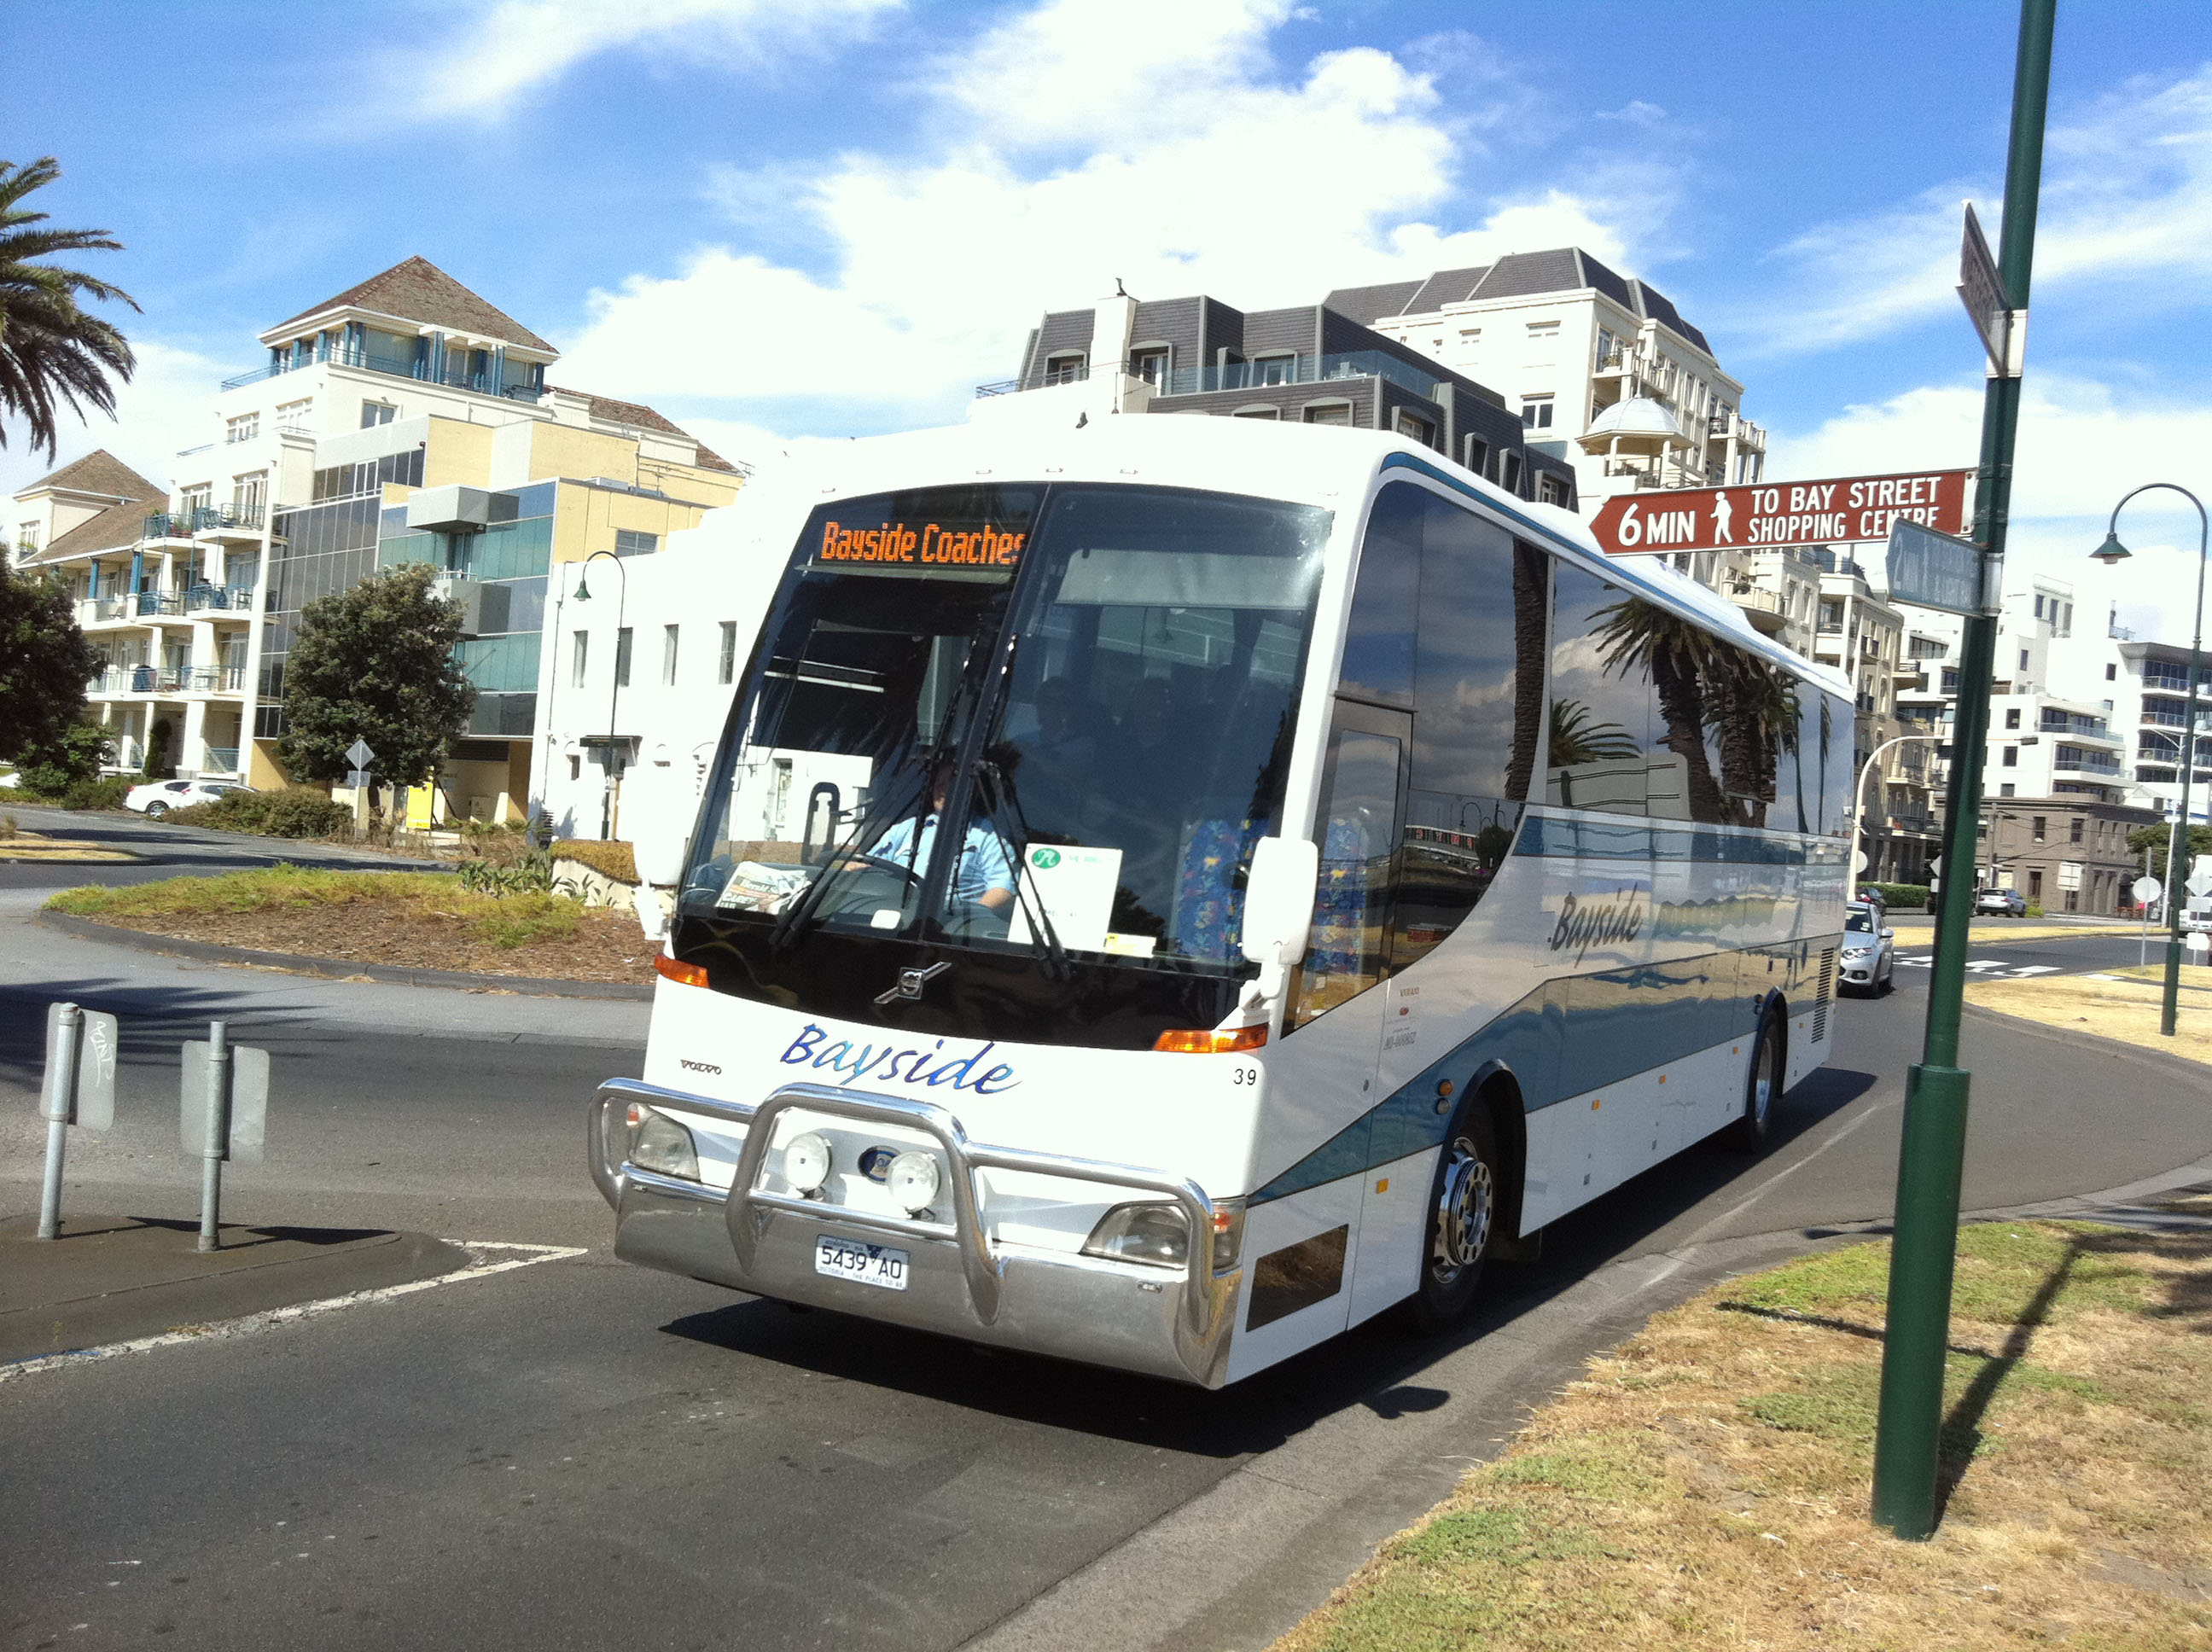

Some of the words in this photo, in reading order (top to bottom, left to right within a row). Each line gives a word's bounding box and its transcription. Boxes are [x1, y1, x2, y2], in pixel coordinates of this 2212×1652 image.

[1751, 487, 1779, 514] TO
[1790, 483, 1837, 512] BAY
[1848, 475, 1941, 508] STREET
[821, 521, 917, 562] Bayside
[1618, 503, 1642, 547] 6
[1646, 509, 1696, 544] MIN
[1747, 511, 1847, 543] SHOPPING
[1551, 881, 1644, 969] Bayside
[680, 1059, 722, 1075] VOLVO
[780, 1023, 1022, 1094] Bayside
[1233, 1068, 1256, 1085] 39
[821, 1245, 867, 1271] 5439
